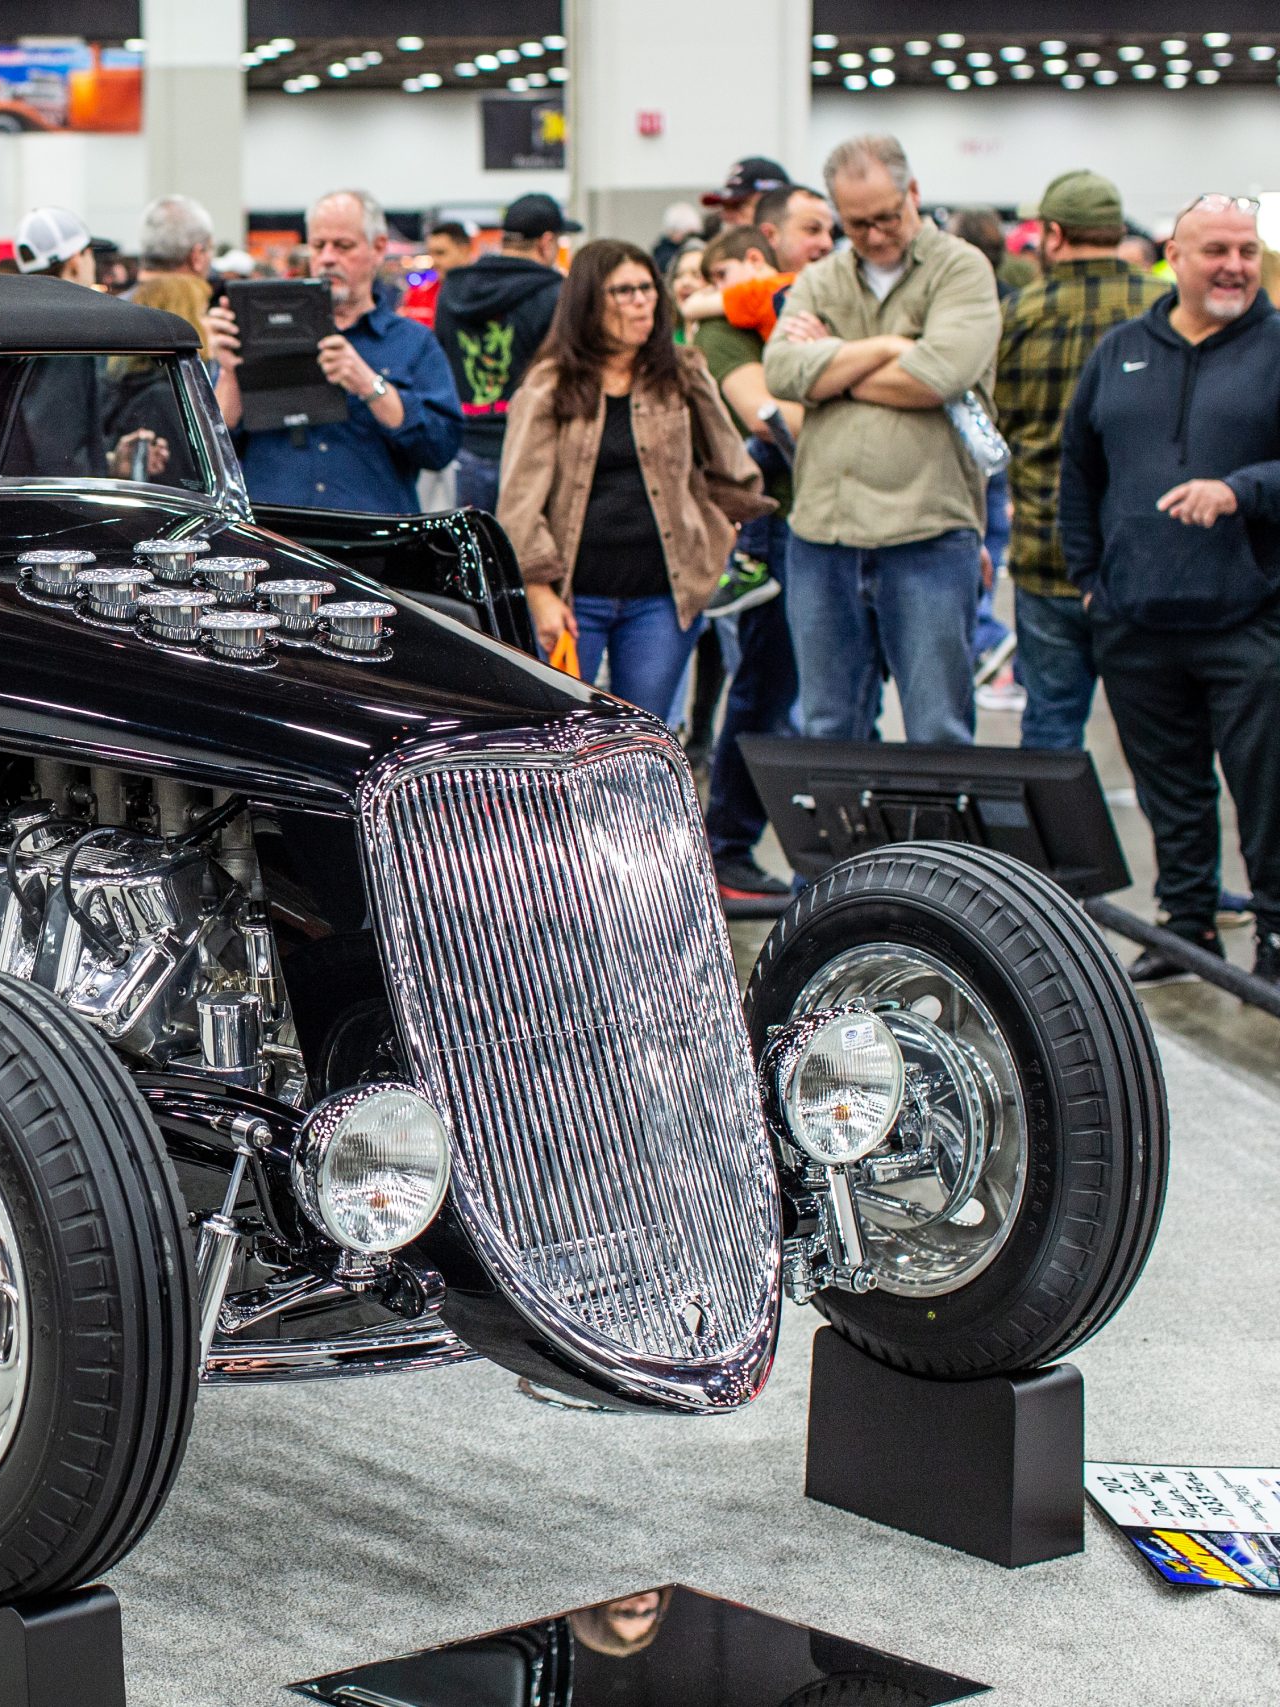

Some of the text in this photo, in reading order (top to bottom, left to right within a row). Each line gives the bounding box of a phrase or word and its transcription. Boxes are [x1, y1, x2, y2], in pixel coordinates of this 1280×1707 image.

[1097, 1475, 1130, 1495] 202
[1175, 1471, 1211, 1493] Ford
[1196, 1495, 1236, 1517] 1933
